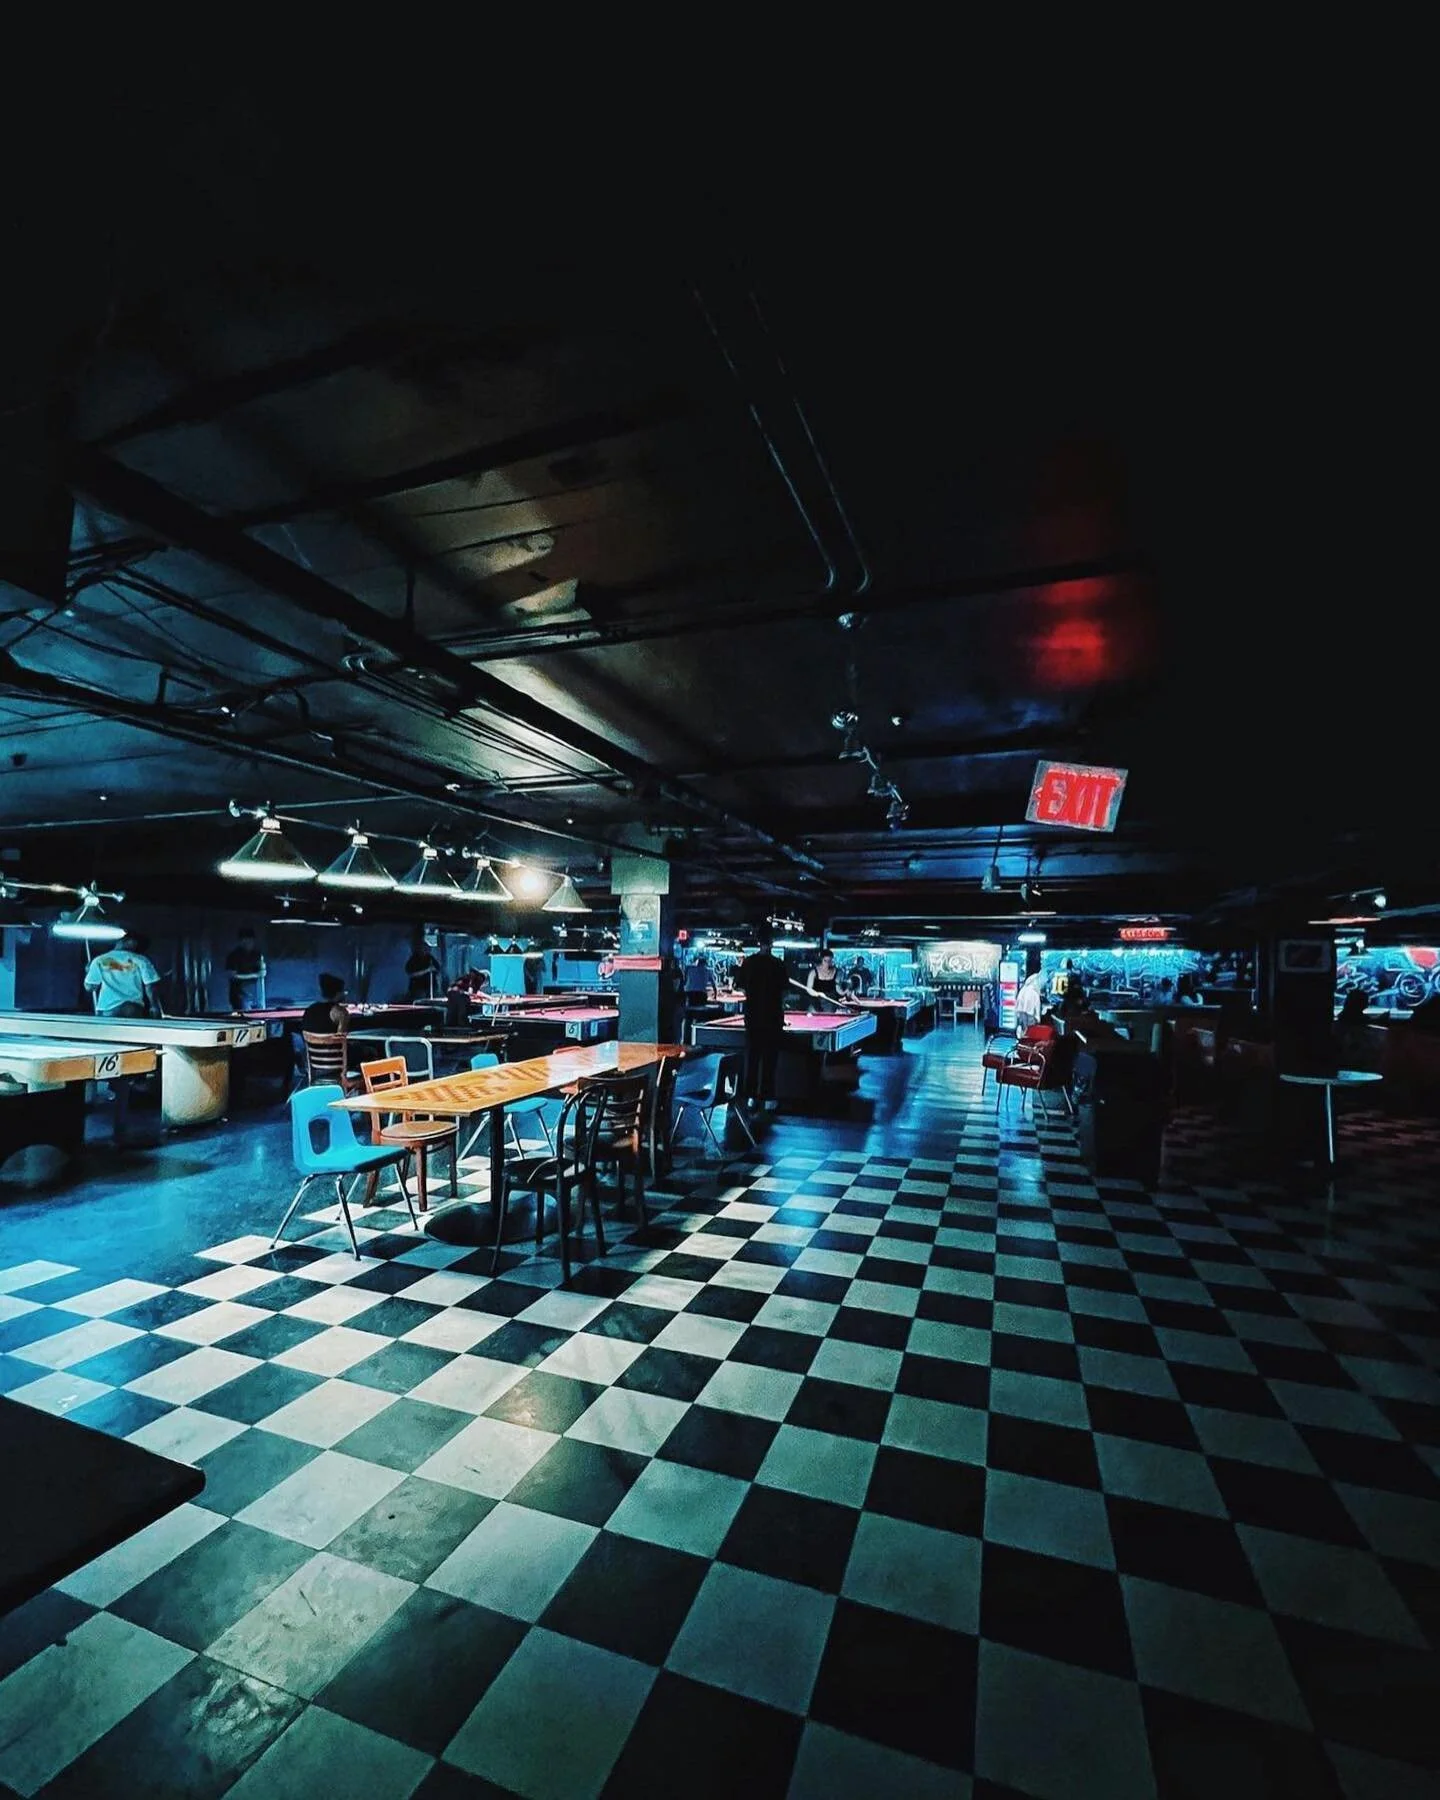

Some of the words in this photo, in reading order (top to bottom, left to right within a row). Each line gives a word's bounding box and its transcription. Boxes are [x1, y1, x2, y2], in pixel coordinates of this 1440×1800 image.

[1037, 769, 1121, 828] EXIT
[235, 1029, 249, 1043] 17
[98, 1054, 119, 1072] 16
